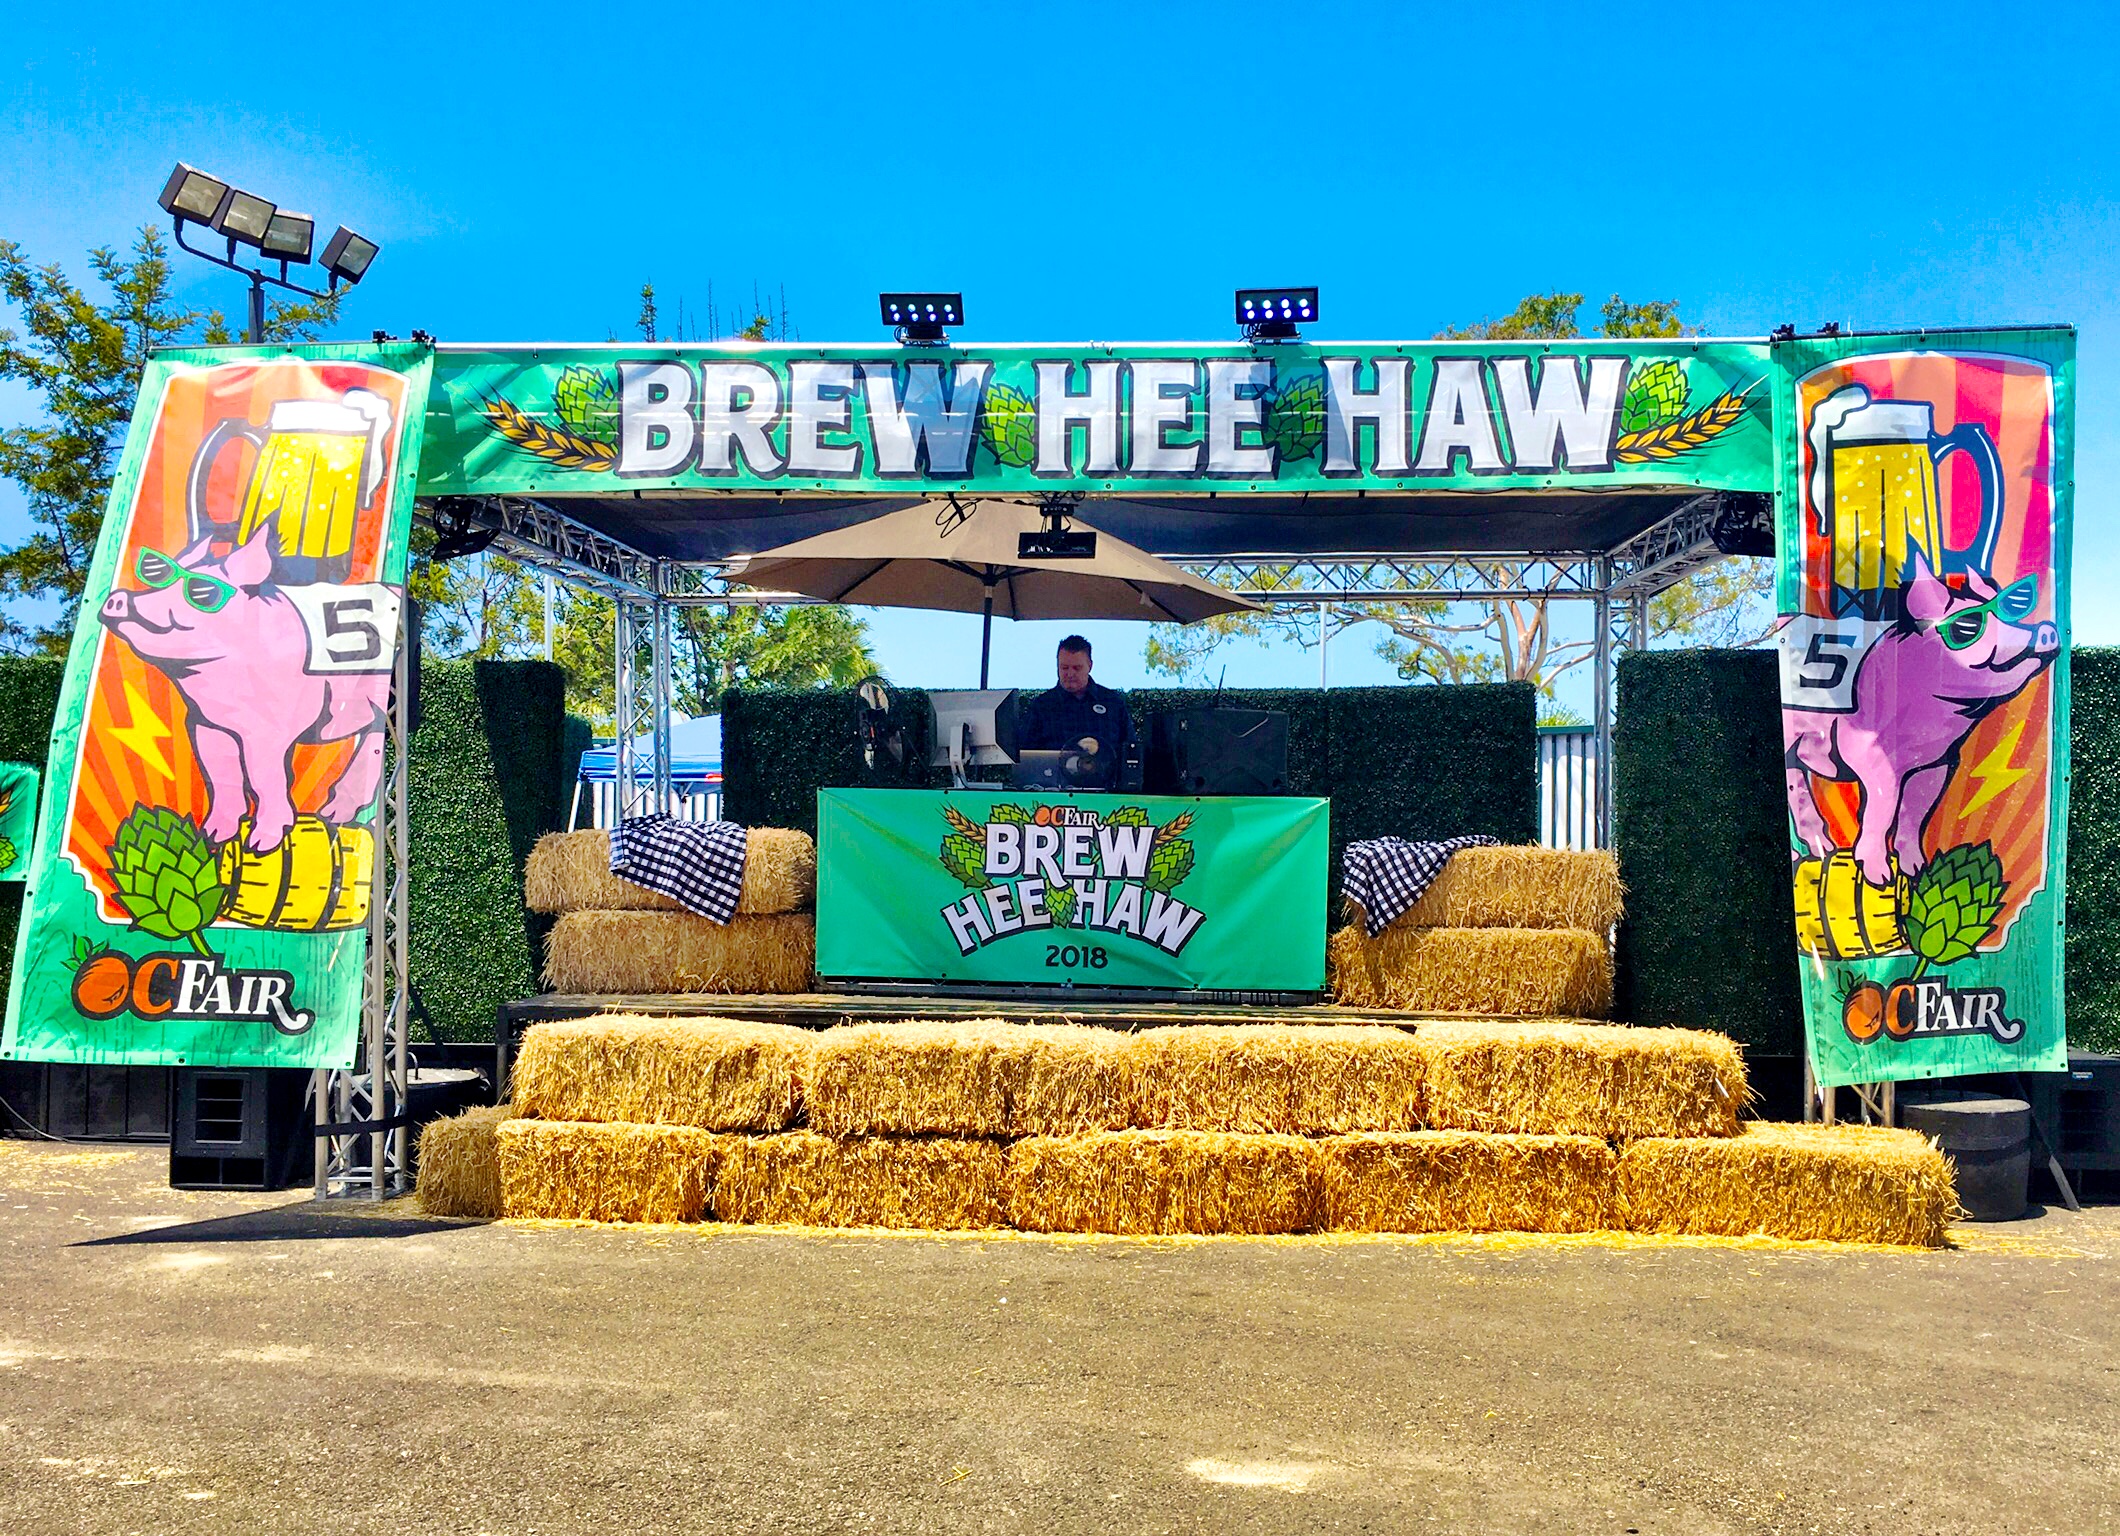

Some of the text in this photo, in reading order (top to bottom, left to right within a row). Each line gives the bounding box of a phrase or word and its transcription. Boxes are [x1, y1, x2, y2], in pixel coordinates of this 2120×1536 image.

[614, 355, 1631, 480] BREW HEE HAW
[322, 599, 382, 663] 5
[1800, 633, 1857, 689] 5
[984, 822, 1156, 888] BREW
[941, 877, 1207, 958] HEE HAW
[1045, 945, 1109, 969] 2018
